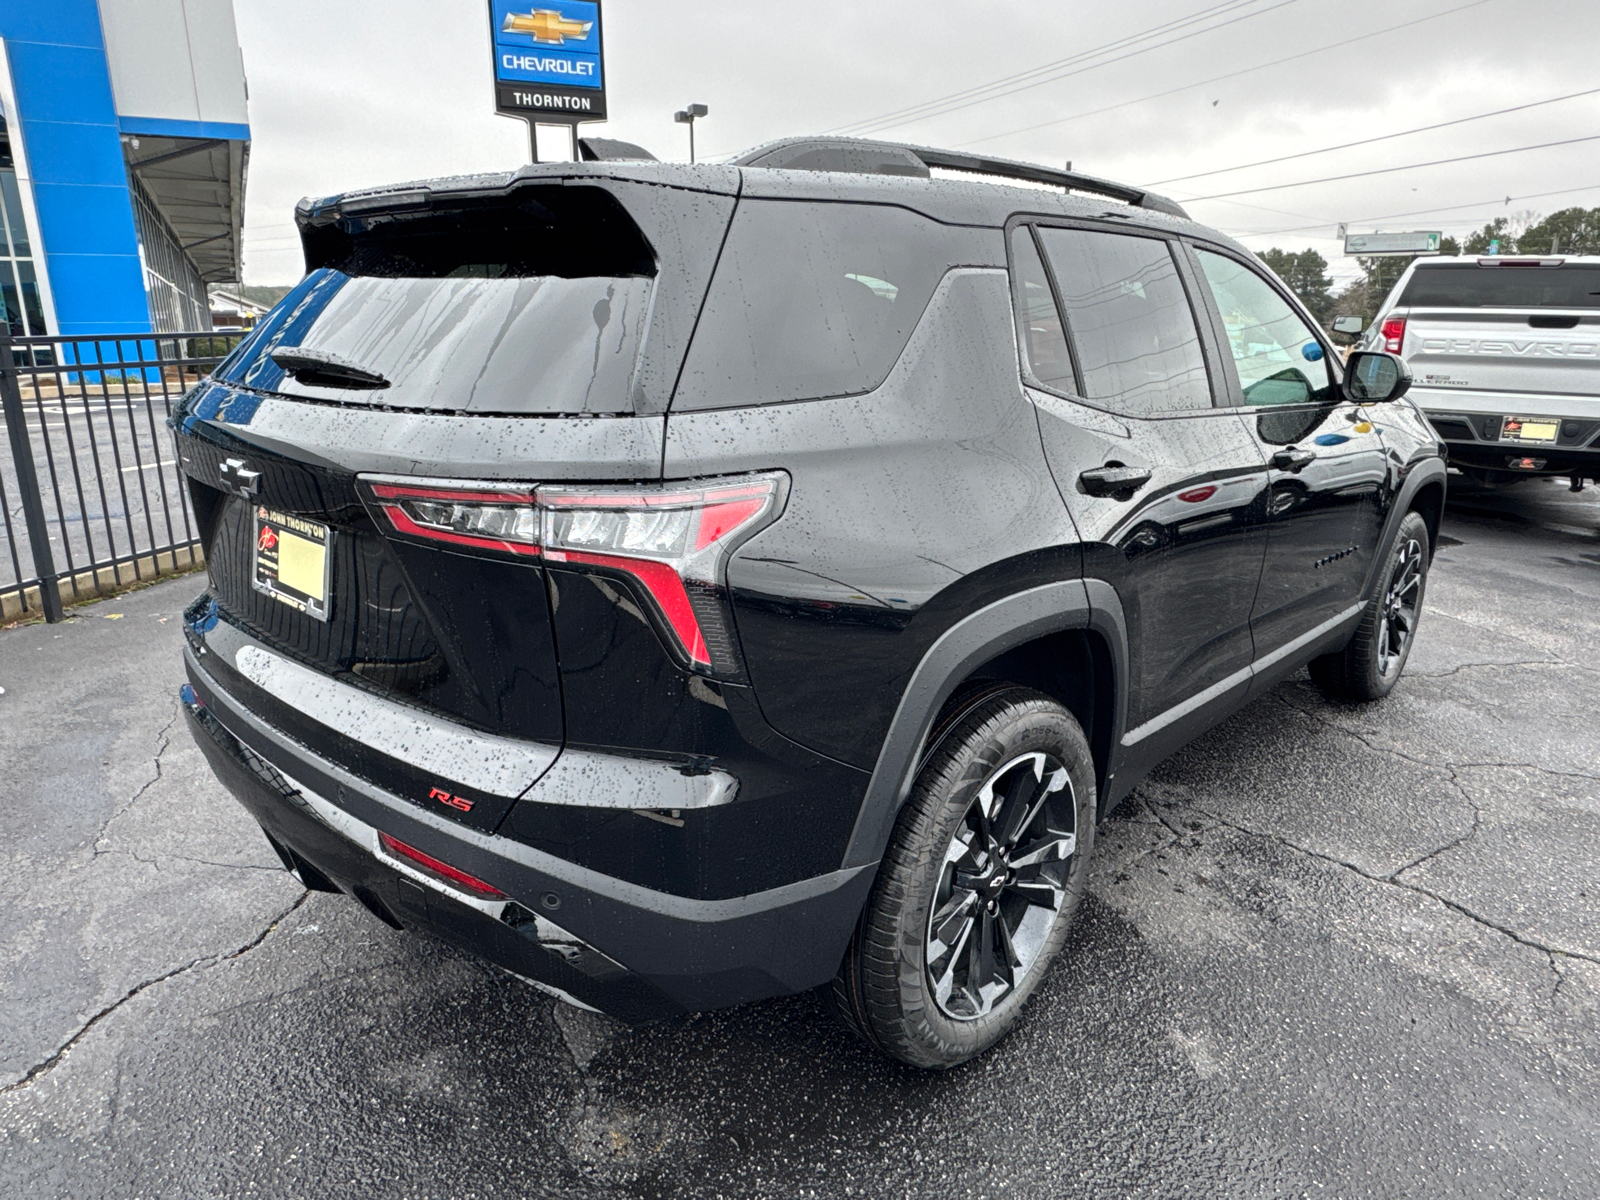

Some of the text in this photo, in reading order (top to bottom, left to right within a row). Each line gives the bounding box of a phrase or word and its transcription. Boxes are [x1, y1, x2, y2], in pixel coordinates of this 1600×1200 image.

[503, 54, 595, 76] CHEVROLET
[513, 92, 591, 110] THORNTON
[1421, 338, 1600, 358] CHEVRO
[269, 510, 286, 526] JOHN
[429, 786, 475, 812] RS
